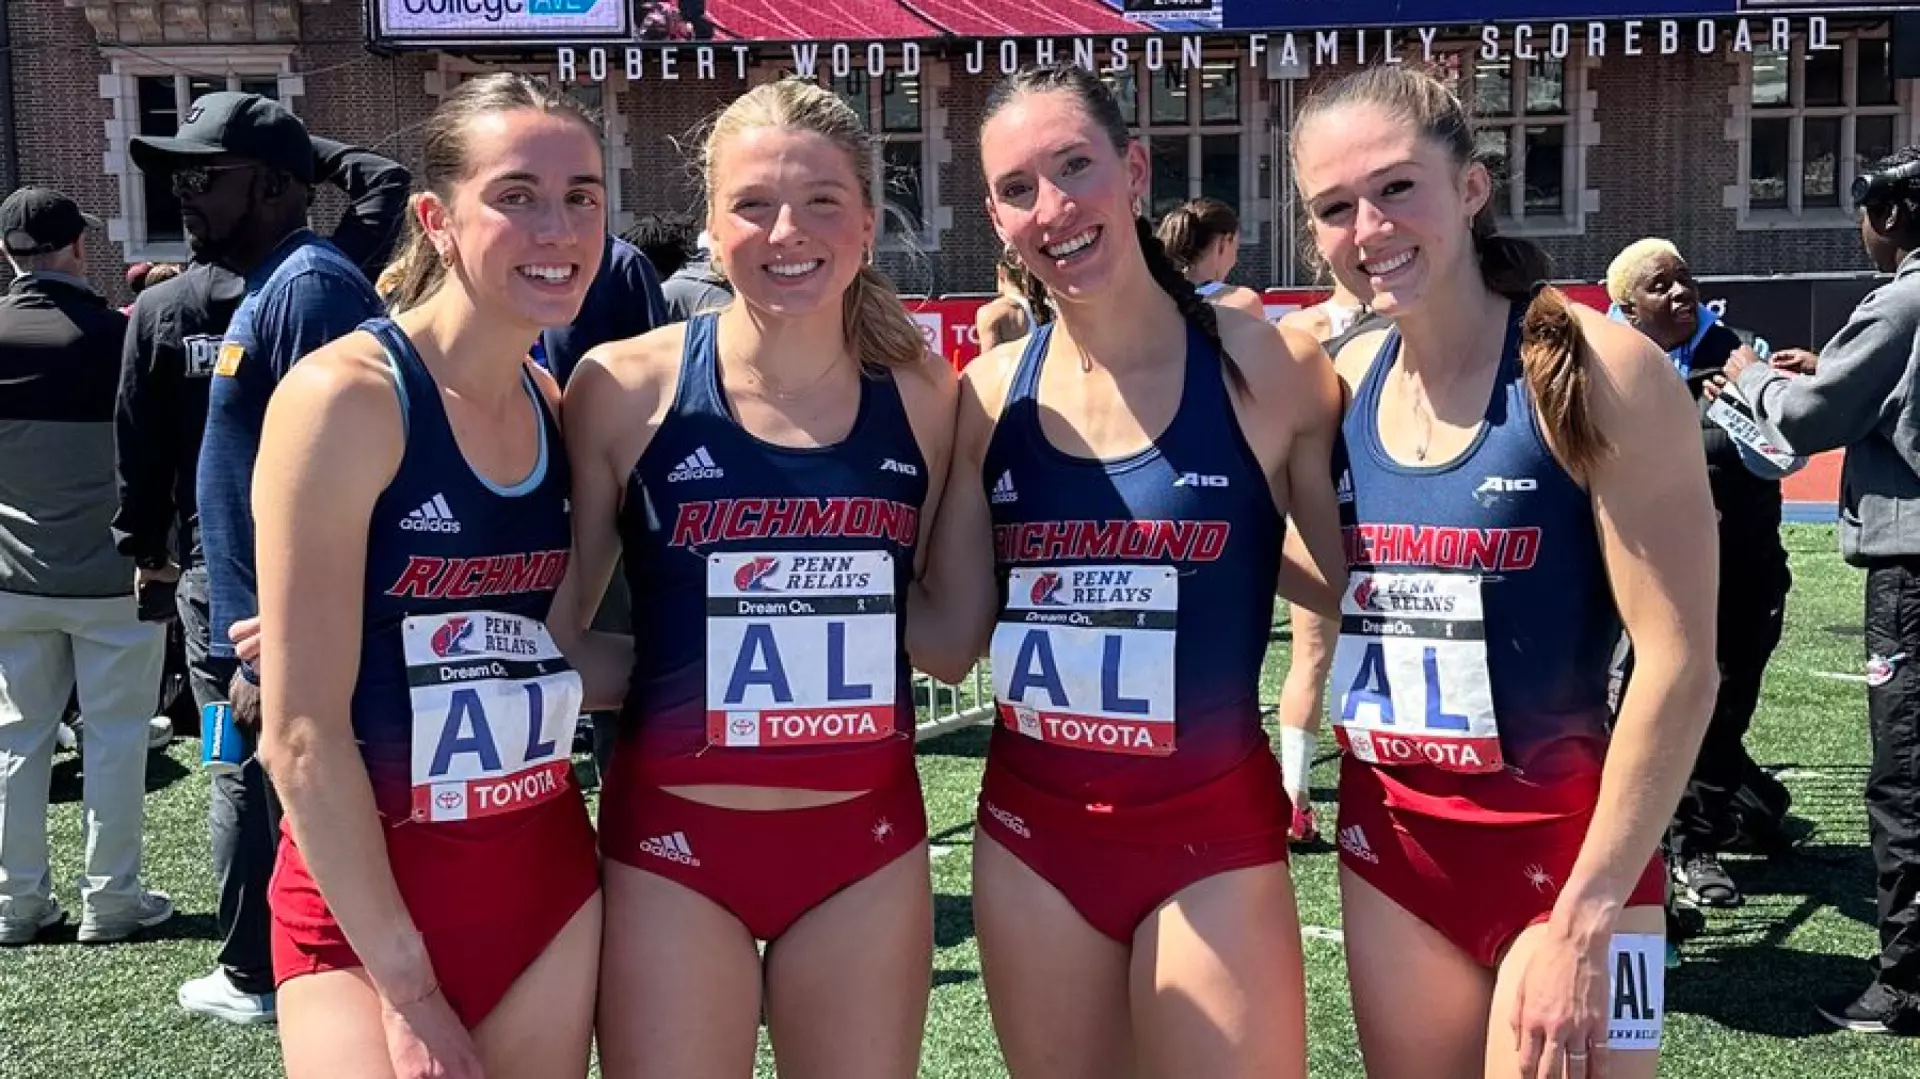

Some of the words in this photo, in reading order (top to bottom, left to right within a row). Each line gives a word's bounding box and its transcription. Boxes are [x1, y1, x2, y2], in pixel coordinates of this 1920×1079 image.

[558, 47, 748, 82] ROBERT
[791, 42, 920, 78] WOOD
[966, 36, 1201, 74] JOHNSON
[1250, 28, 1436, 67] FAMILY
[1481, 17, 1828, 60] SCOREBOARD
[667, 467, 724, 483] adidas
[1172, 471, 1230, 487] A10
[1475, 477, 1538, 491] A10
[400, 517, 462, 533] adidas
[667, 497, 919, 547] RICHMOND
[790, 556, 853, 572] PENN
[785, 573, 870, 589] RELAYS
[1072, 571, 1134, 586] PENN
[1072, 588, 1153, 604] RELAYS
[1390, 595, 1456, 612] RELAYS
[738, 601, 786, 614] Dream
[789, 600, 815, 613] On.
[485, 616, 523, 636] PENN
[1025, 611, 1067, 622] Dream
[1069, 612, 1093, 625] On.
[485, 635, 539, 655] RELAYS
[440, 665, 490, 681] Dream
[766, 712, 877, 739] TOYOTA
[1045, 718, 1154, 747] TOYOTA
[1376, 737, 1482, 766] TOYOTA
[474, 770, 556, 809] TOYOTA
[640, 841, 700, 867] adidas
[1613, 951, 1655, 1019] AL
